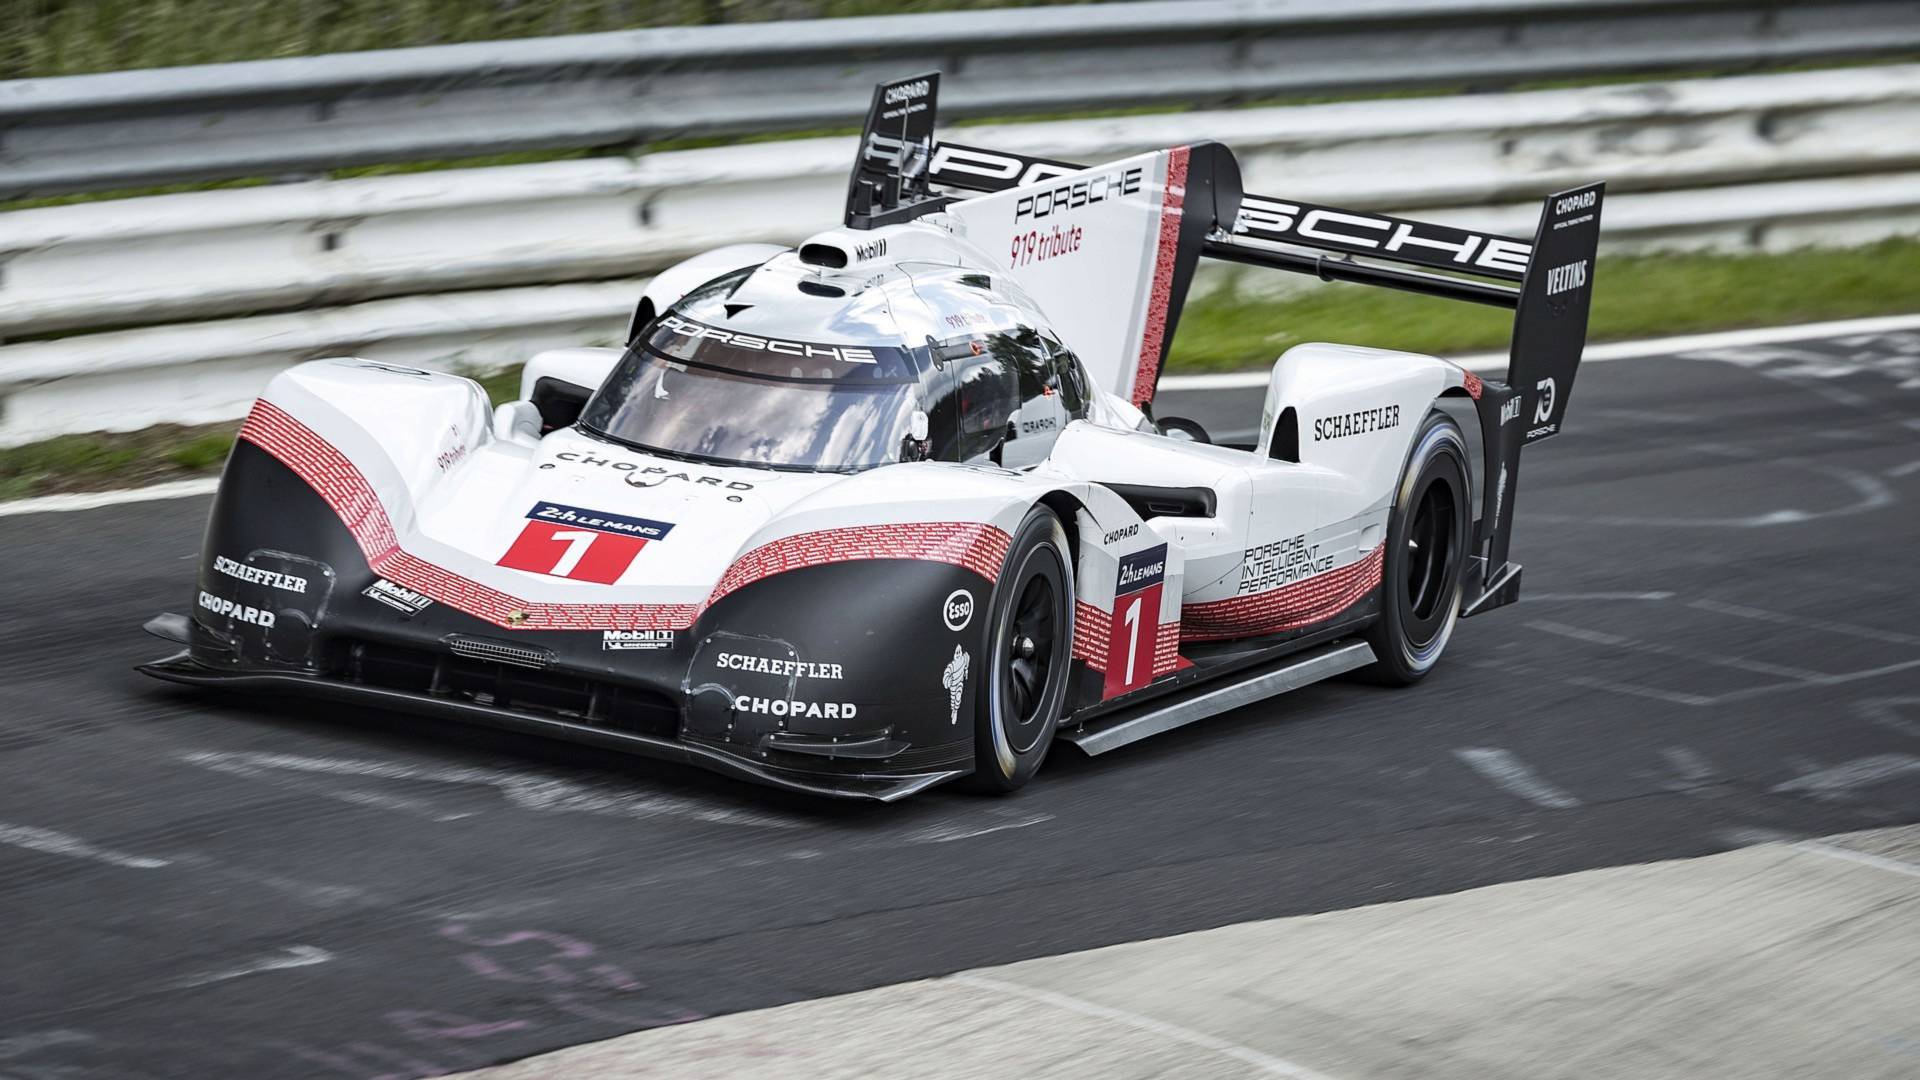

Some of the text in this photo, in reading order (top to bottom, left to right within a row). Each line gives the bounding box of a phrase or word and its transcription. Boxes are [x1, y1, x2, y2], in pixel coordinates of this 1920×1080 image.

[1015, 168, 1142, 224] PORSCHE
[1555, 191, 1596, 215] CHOPARD
[1011, 225, 1082, 269] 919 tribute
[1547, 259, 1587, 295] VELTINS
[657, 316, 878, 364] PORSCHE
[1314, 404, 1400, 442] SCHAEFFLER
[556, 452, 754, 491] CHOPARD
[577, 516, 603, 525] LE
[603, 520, 662, 535] MANS
[1104, 523, 1139, 545] CHOPARD
[549, 530, 599, 577] 1
[1242, 544, 1320, 580] INTELLIGENT
[1244, 534, 1305, 563] PORSCHE
[213, 555, 308, 594] SCHAEFFLER
[1134, 568, 1144, 582] LE
[1143, 561, 1164, 578] MANS
[1237, 555, 1334, 594] PERFORMANCE
[372, 579, 420, 602] Mobil
[198, 591, 276, 628] CHOPARD
[604, 630, 655, 640] Mobil
[1125, 597, 1142, 686] 1
[717, 652, 843, 680] SCHAEFFLER
[735, 695, 857, 719] CHOPARD
